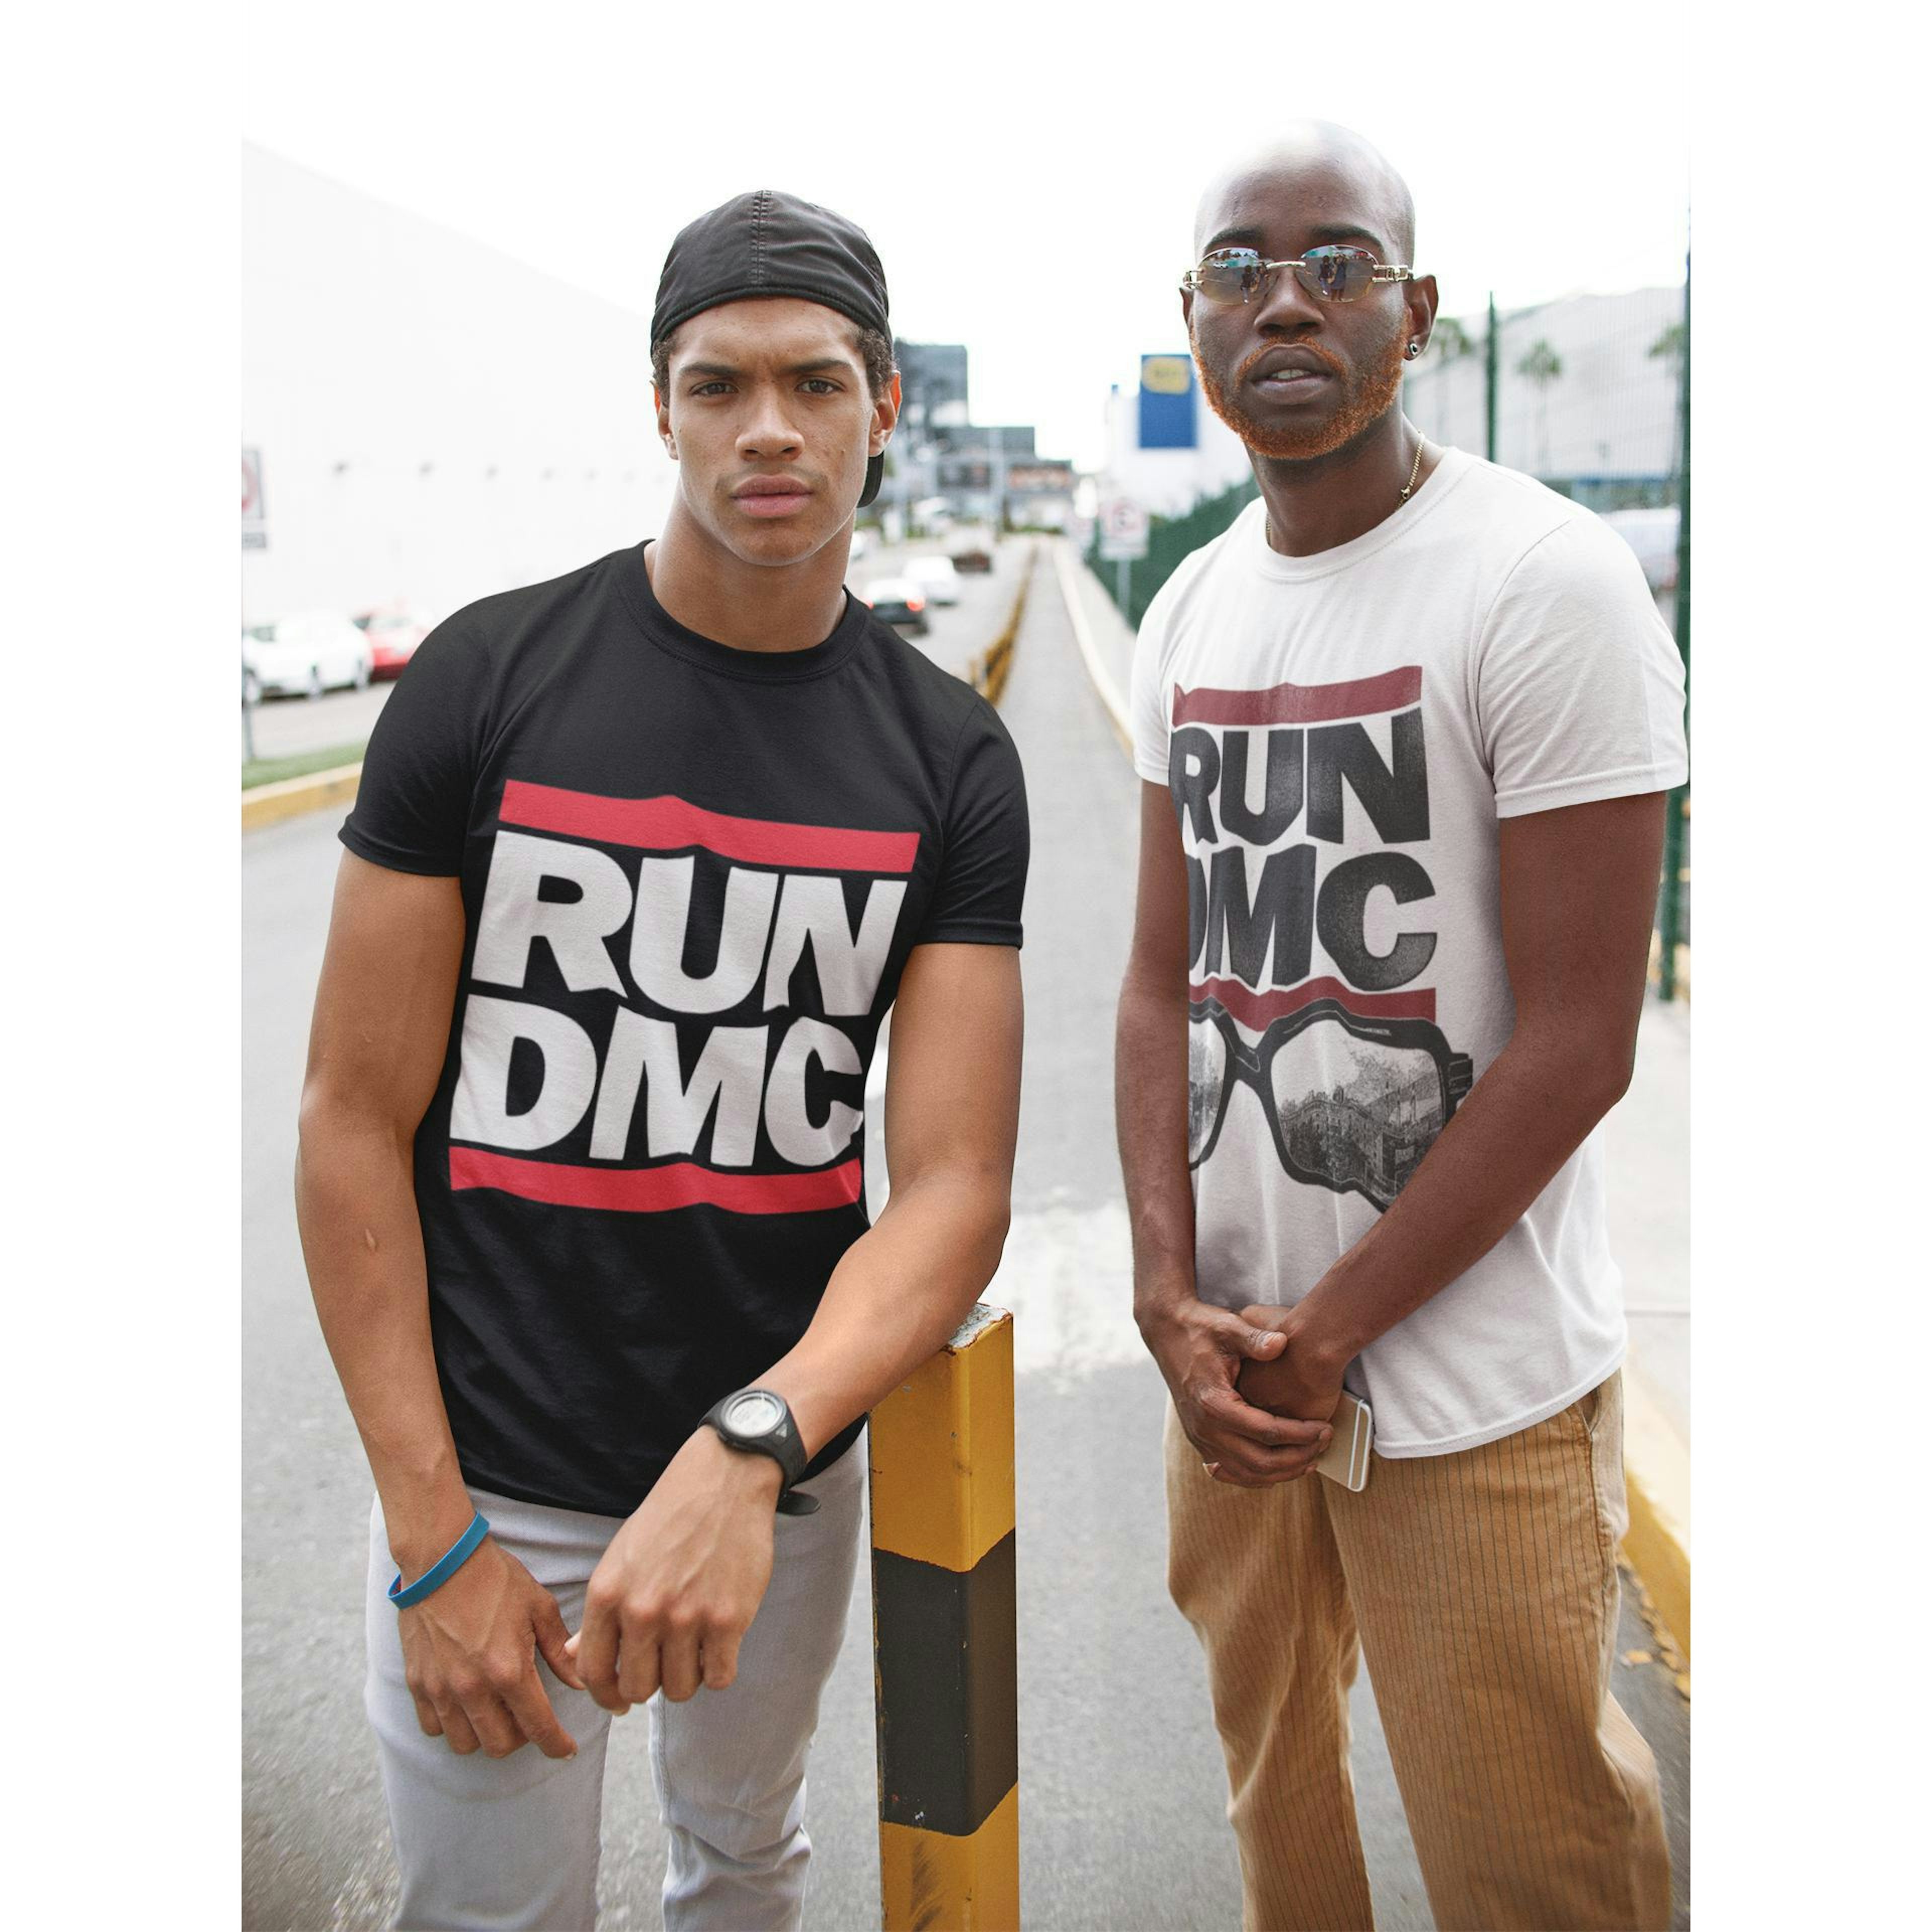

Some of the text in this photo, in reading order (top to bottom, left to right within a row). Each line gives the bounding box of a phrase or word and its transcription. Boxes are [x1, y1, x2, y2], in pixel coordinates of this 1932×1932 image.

[1168, 706, 1430, 846] RUN
[471, 830, 908, 1016] RUN
[449, 993, 864, 1167] DMC
